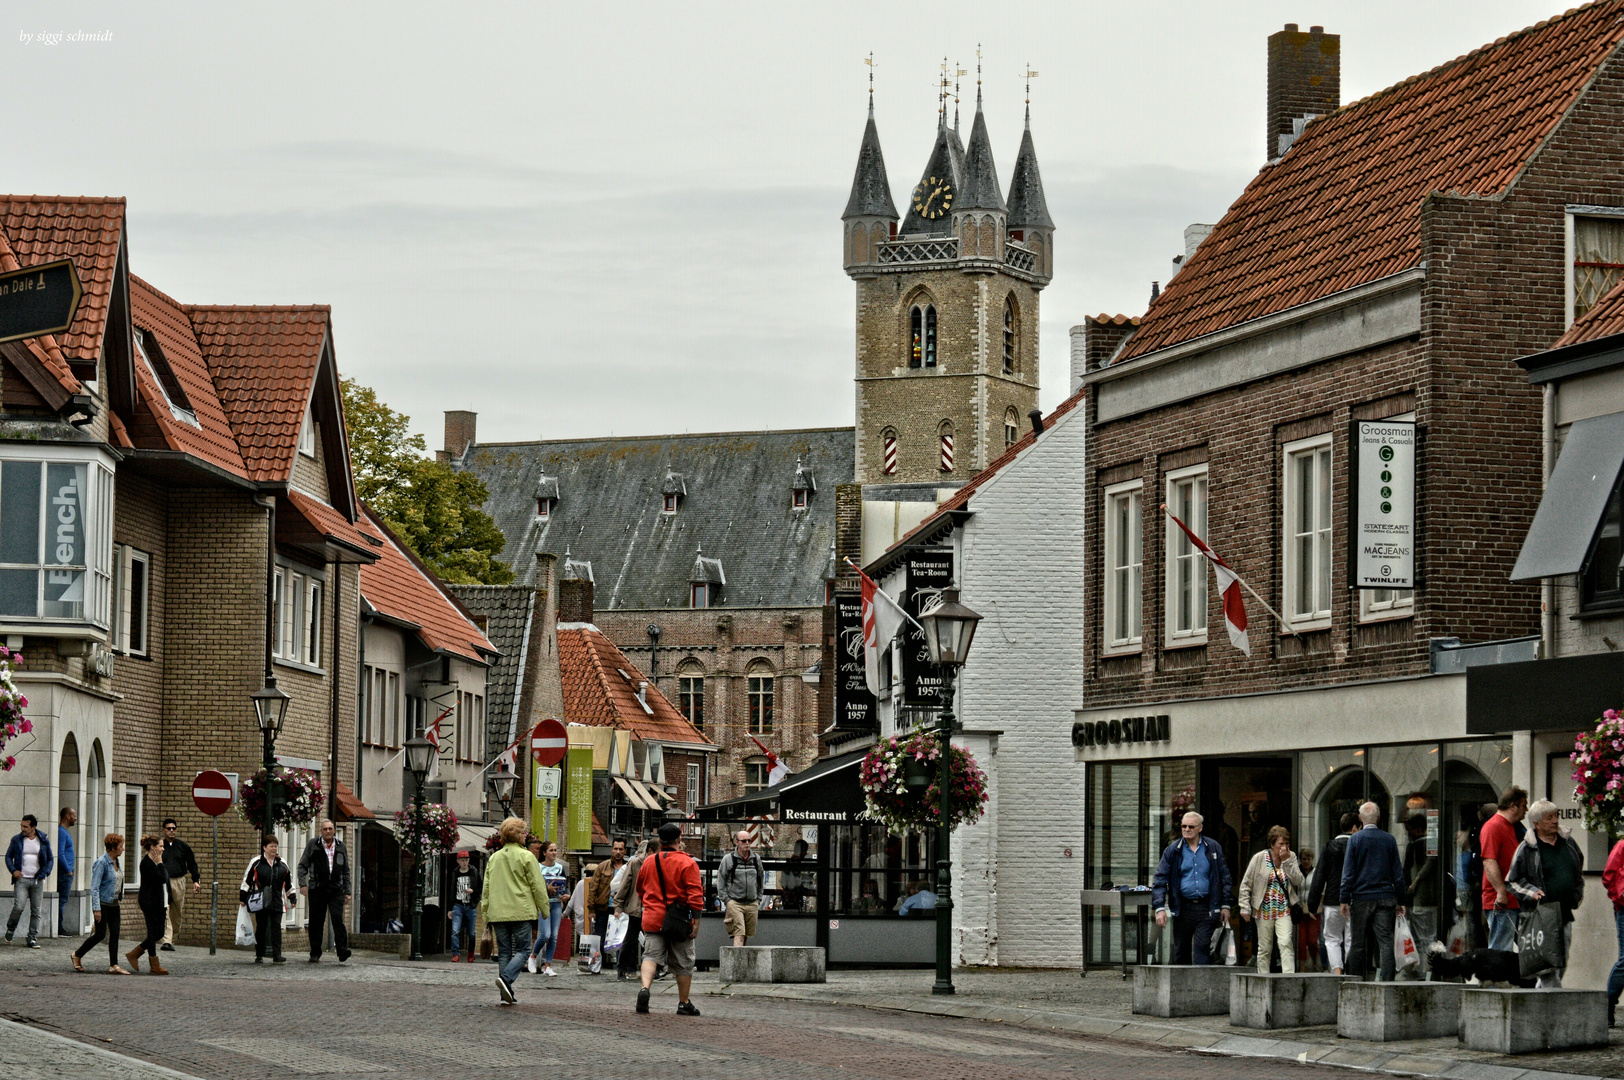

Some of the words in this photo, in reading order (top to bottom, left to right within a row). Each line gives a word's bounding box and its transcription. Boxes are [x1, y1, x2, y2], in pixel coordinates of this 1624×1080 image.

[12, 277, 34, 293] Dale
[1361, 424, 1413, 436] Groosman
[1362, 436, 1380, 444] Jeans
[910, 561, 949, 569] Restaurant
[911, 569, 948, 577] Tea-Room
[915, 675, 942, 685] Anno
[917, 686, 939, 696] 1957
[845, 701, 868, 710] Anno
[847, 710, 867, 720] 1957
[1071, 714, 1170, 747] GROOSMAN
[785, 808, 847, 821] Restaurant
